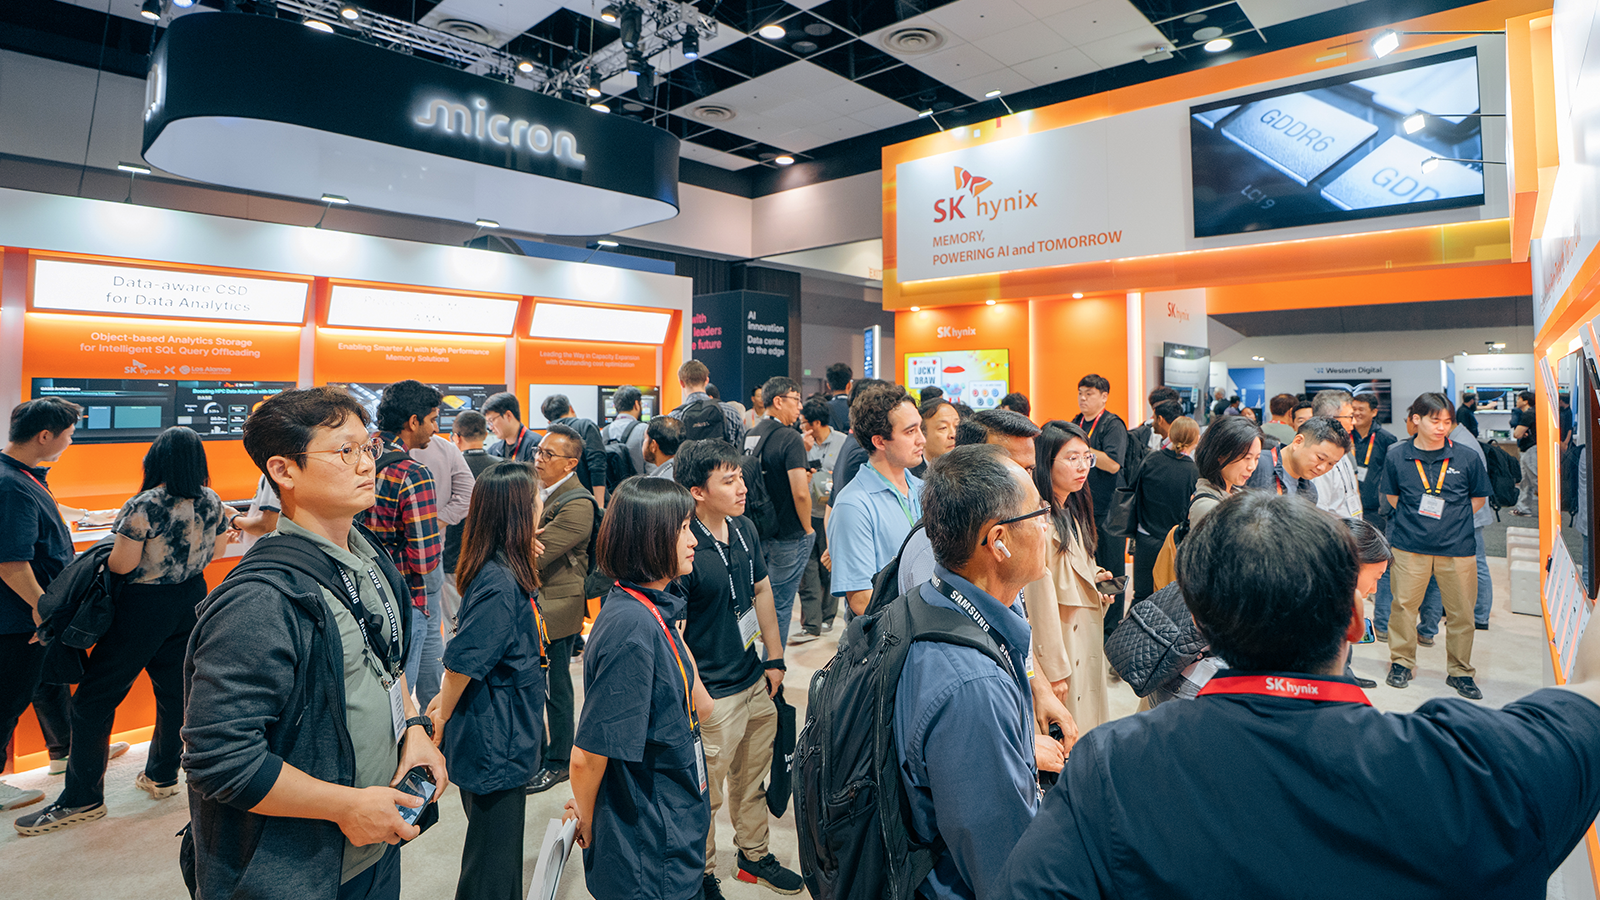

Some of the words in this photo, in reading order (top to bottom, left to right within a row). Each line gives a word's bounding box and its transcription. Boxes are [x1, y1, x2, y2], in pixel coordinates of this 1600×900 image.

[415, 98, 587, 163] micron
[1259, 108, 1336, 153] GDDR6
[933, 195, 966, 223] SK
[976, 189, 1039, 221] hynix
[932, 230, 986, 248] MEMORY,
[932, 246, 995, 266] POWERING
[997, 245, 1010, 258] AI
[1012, 241, 1035, 256] and
[1036, 230, 1123, 253] TOMORROW
[113, 275, 211, 293] Data-aware
[215, 284, 248, 296] CSD
[106, 292, 130, 303] for
[135, 294, 174, 307] Data
[178, 297, 251, 312] Analytics
[1167, 302, 1176, 318] SK
[747, 310, 757, 320] AI
[693, 325, 722, 337] leaders
[937, 326, 952, 338] SK
[951, 326, 977, 339] hynix
[91, 332, 165, 343] Object-based
[167, 335, 214, 346] Analytics
[215, 337, 253, 349] Storage
[697, 339, 722, 350] future
[747, 334, 764, 345] Data
[763, 337, 785, 346] center
[79, 342, 96, 352] for
[98, 343, 153, 355] Intelligent
[155, 345, 177, 355] SQL
[178, 346, 209, 357] Query
[211, 347, 261, 358] Offloading
[338, 342, 372, 352] Enabling
[373, 344, 403, 352] Smarter
[404, 345, 413, 353] AI
[414, 345, 430, 353] with
[430, 346, 447, 355] High
[448, 347, 490, 356] Performance
[747, 346, 755, 354] to
[756, 346, 767, 355] the
[768, 346, 785, 357] edge
[385, 353, 416, 363] Memory
[417, 354, 450, 363] Solutions
[559, 359, 592, 367] Outstanding
[124, 366, 138, 374] SK
[1357, 366, 1383, 374] Digital
[914, 376, 936, 385] DRAW
[949, 589, 991, 633] SAMSUNG
[384, 601, 399, 643] SAMSUNG
[1265, 677, 1285, 691] SK
[1286, 681, 1319, 696] hynix
